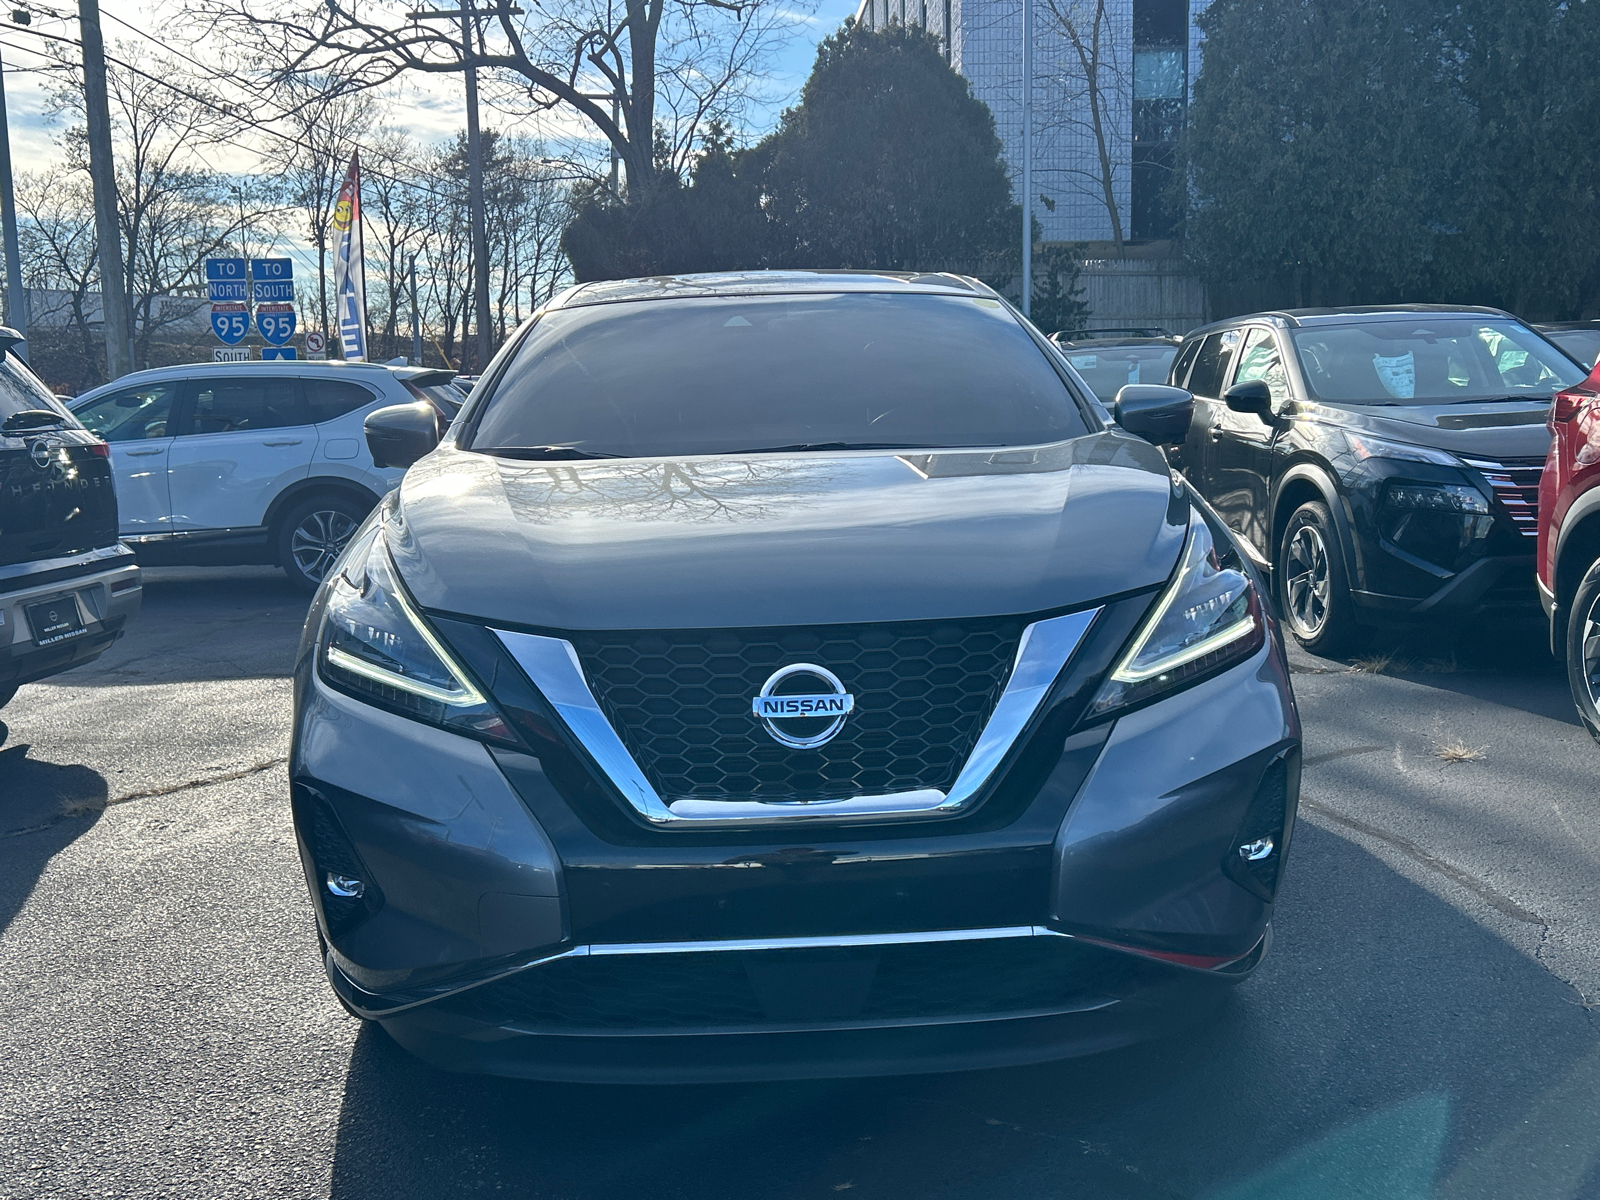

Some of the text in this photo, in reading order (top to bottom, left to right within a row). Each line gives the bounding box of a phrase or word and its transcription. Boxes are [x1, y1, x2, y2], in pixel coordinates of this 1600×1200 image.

[216, 263, 236, 275] TO
[262, 263, 282, 276] TO
[209, 283, 247, 297] NORTH
[255, 284, 293, 298] SOUTH
[217, 317, 245, 337] 95
[262, 317, 291, 337] 95
[215, 350, 250, 362] SOUTH
[39, 628, 88, 645] MILLER NISSAN
[764, 698, 844, 713] NISSAN
